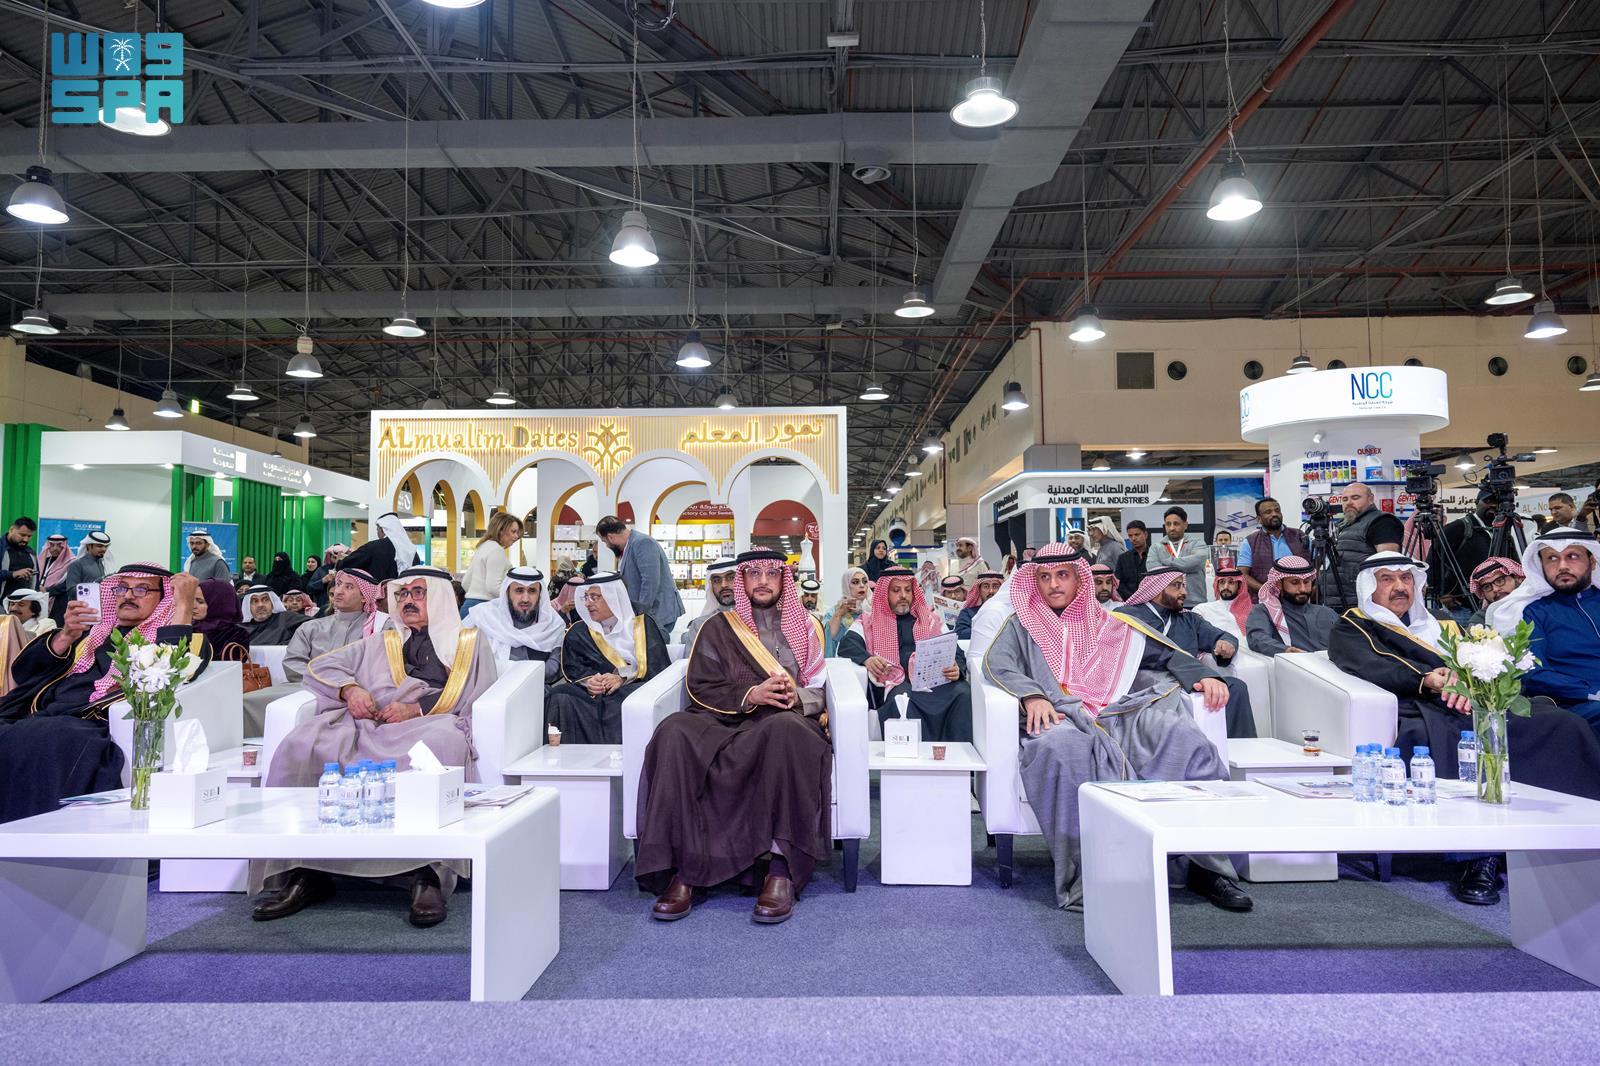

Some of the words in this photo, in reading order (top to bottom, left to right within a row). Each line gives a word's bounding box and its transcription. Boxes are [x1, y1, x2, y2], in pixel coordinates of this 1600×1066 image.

[1351, 371, 1393, 400] NCC
[511, 425, 579, 449] Dates
[681, 420, 759, 451] المعلم
[765, 418, 825, 443] تمور
[1047, 484, 1085, 495] المعدنية
[1086, 484, 1124, 494] للصناعات
[1124, 484, 1149, 496] النافع
[1329, 494, 1343, 504] GENT
